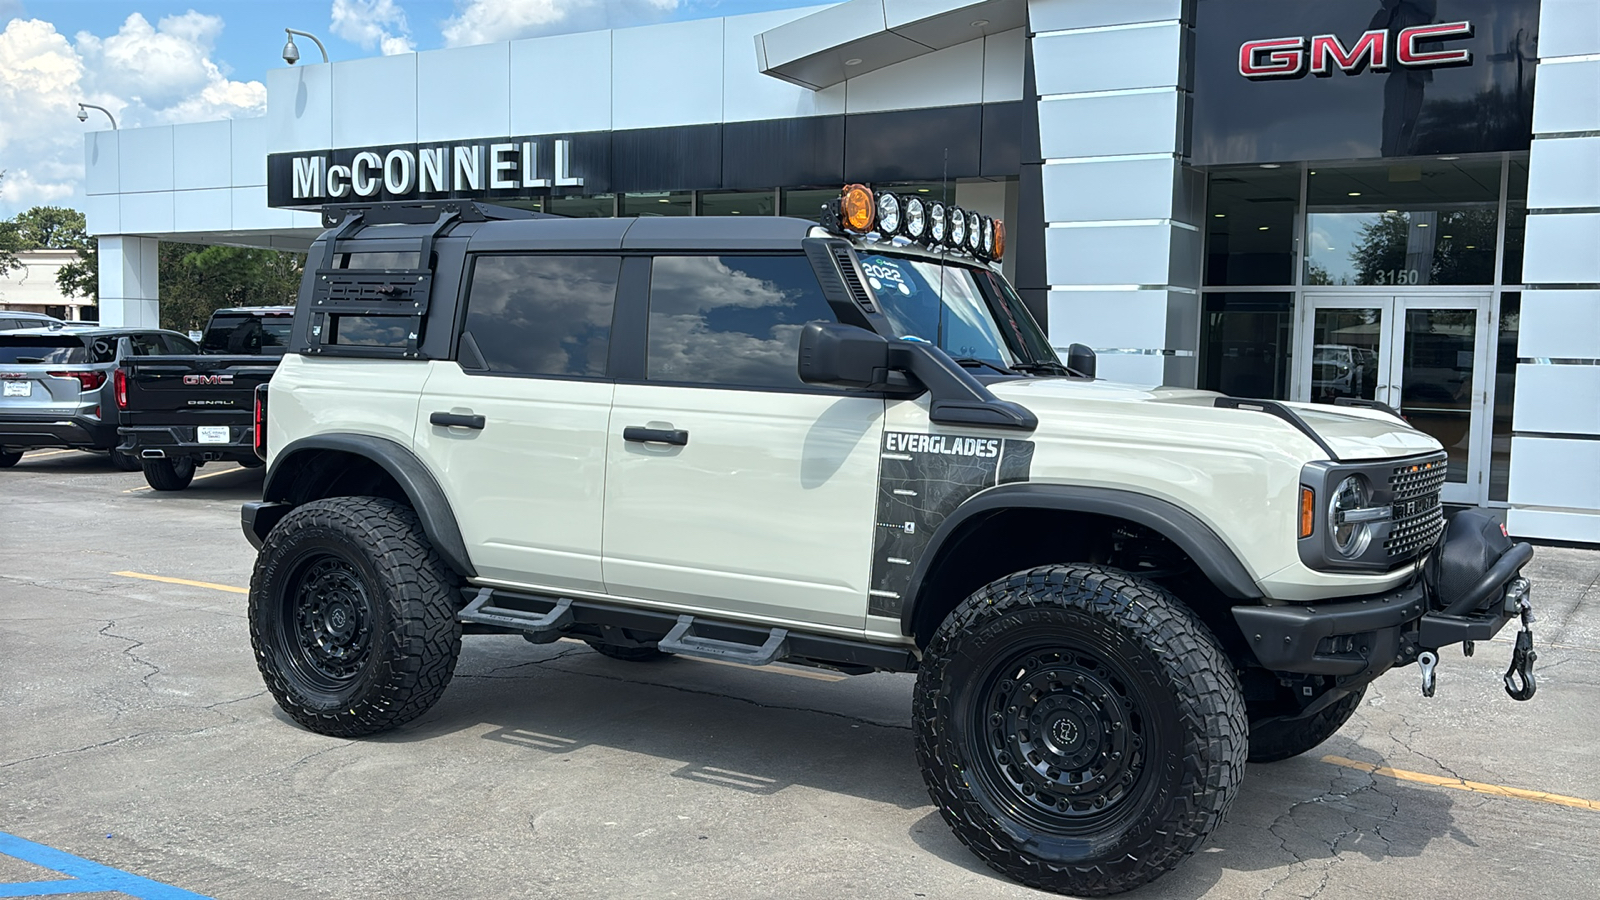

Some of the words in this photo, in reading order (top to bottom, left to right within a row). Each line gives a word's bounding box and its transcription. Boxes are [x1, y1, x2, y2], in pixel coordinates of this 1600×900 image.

[1239, 21, 1473, 78] GMC
[292, 139, 584, 199] McCONNELL
[862, 262, 904, 283] 2022
[1375, 269, 1419, 285] 3150
[183, 374, 234, 385] GMC
[886, 433, 998, 458] EVERGLADES
